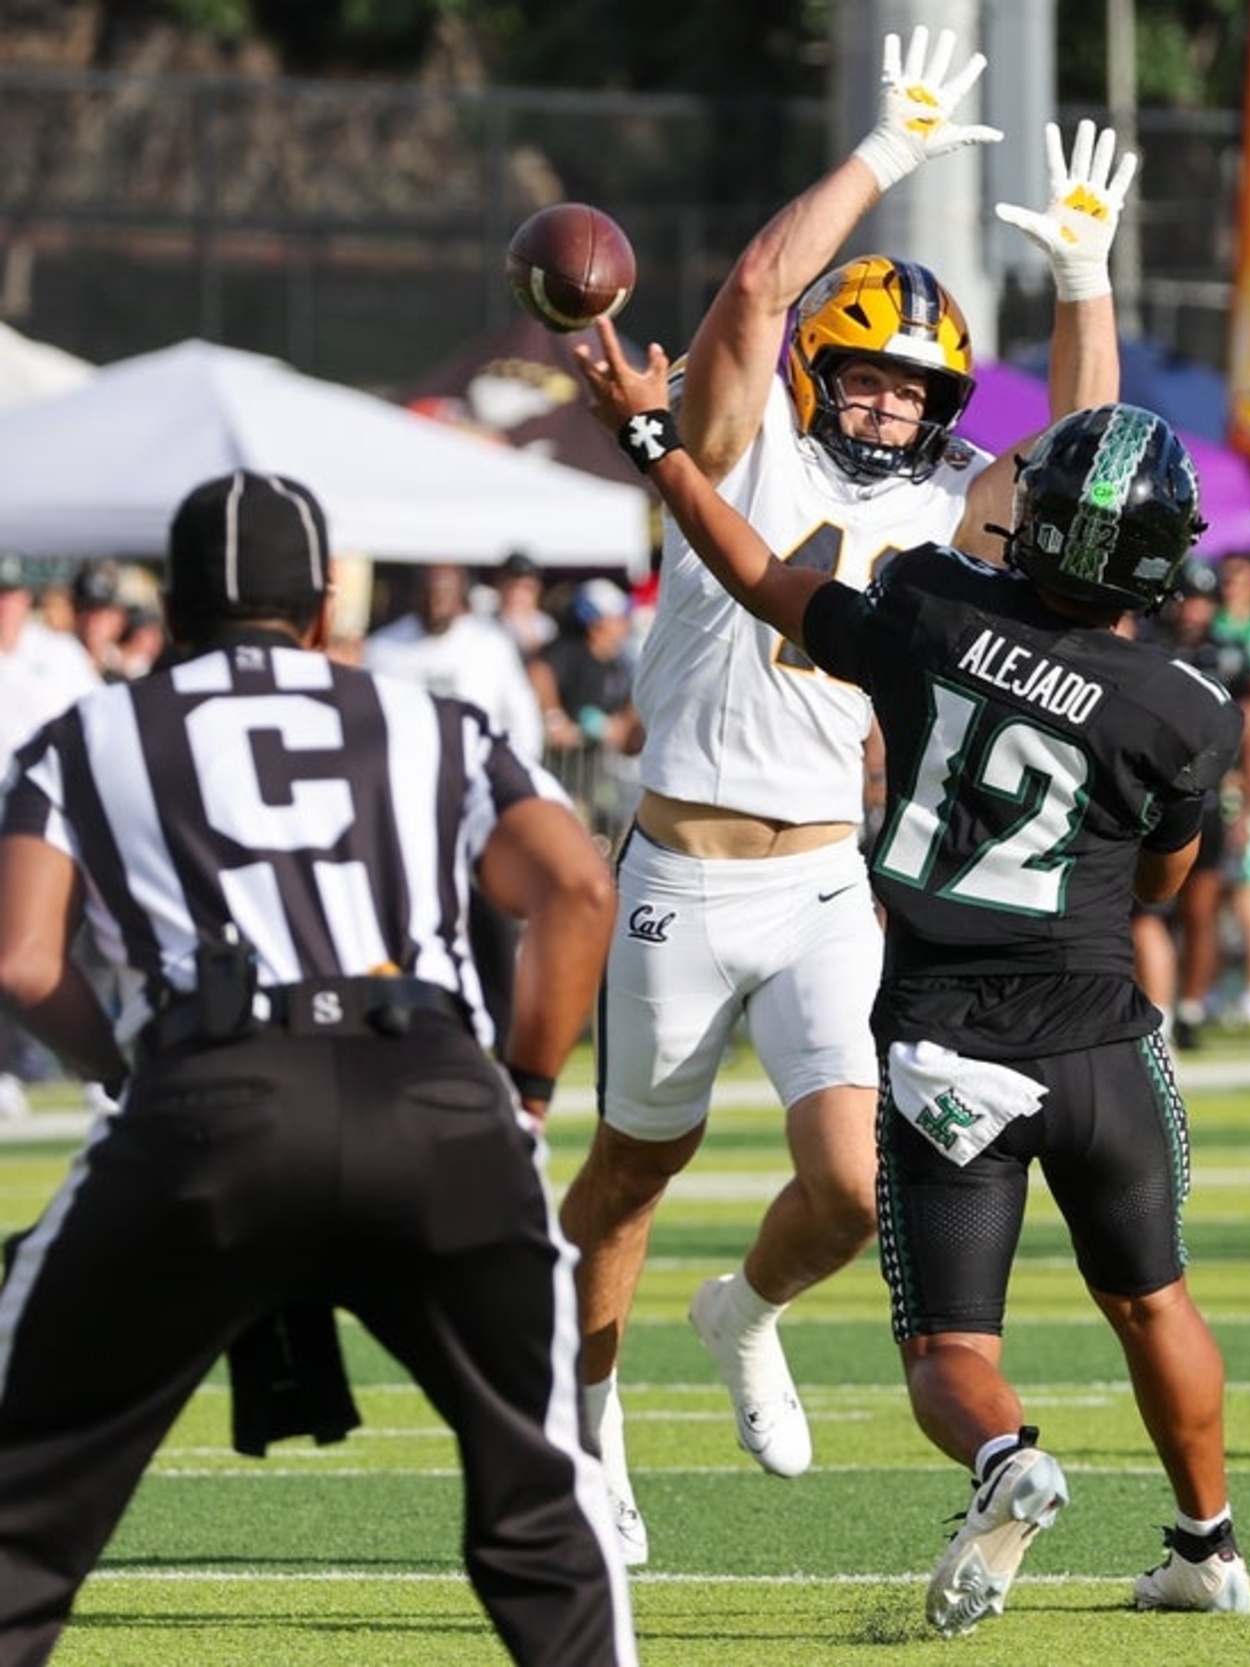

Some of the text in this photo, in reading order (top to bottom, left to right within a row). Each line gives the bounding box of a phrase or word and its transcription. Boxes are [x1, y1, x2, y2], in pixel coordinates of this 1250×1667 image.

[958, 629, 1103, 724] ALEJADO
[184, 694, 355, 851] C
[873, 672, 1093, 918] 12
[627, 904, 676, 942] Cal
